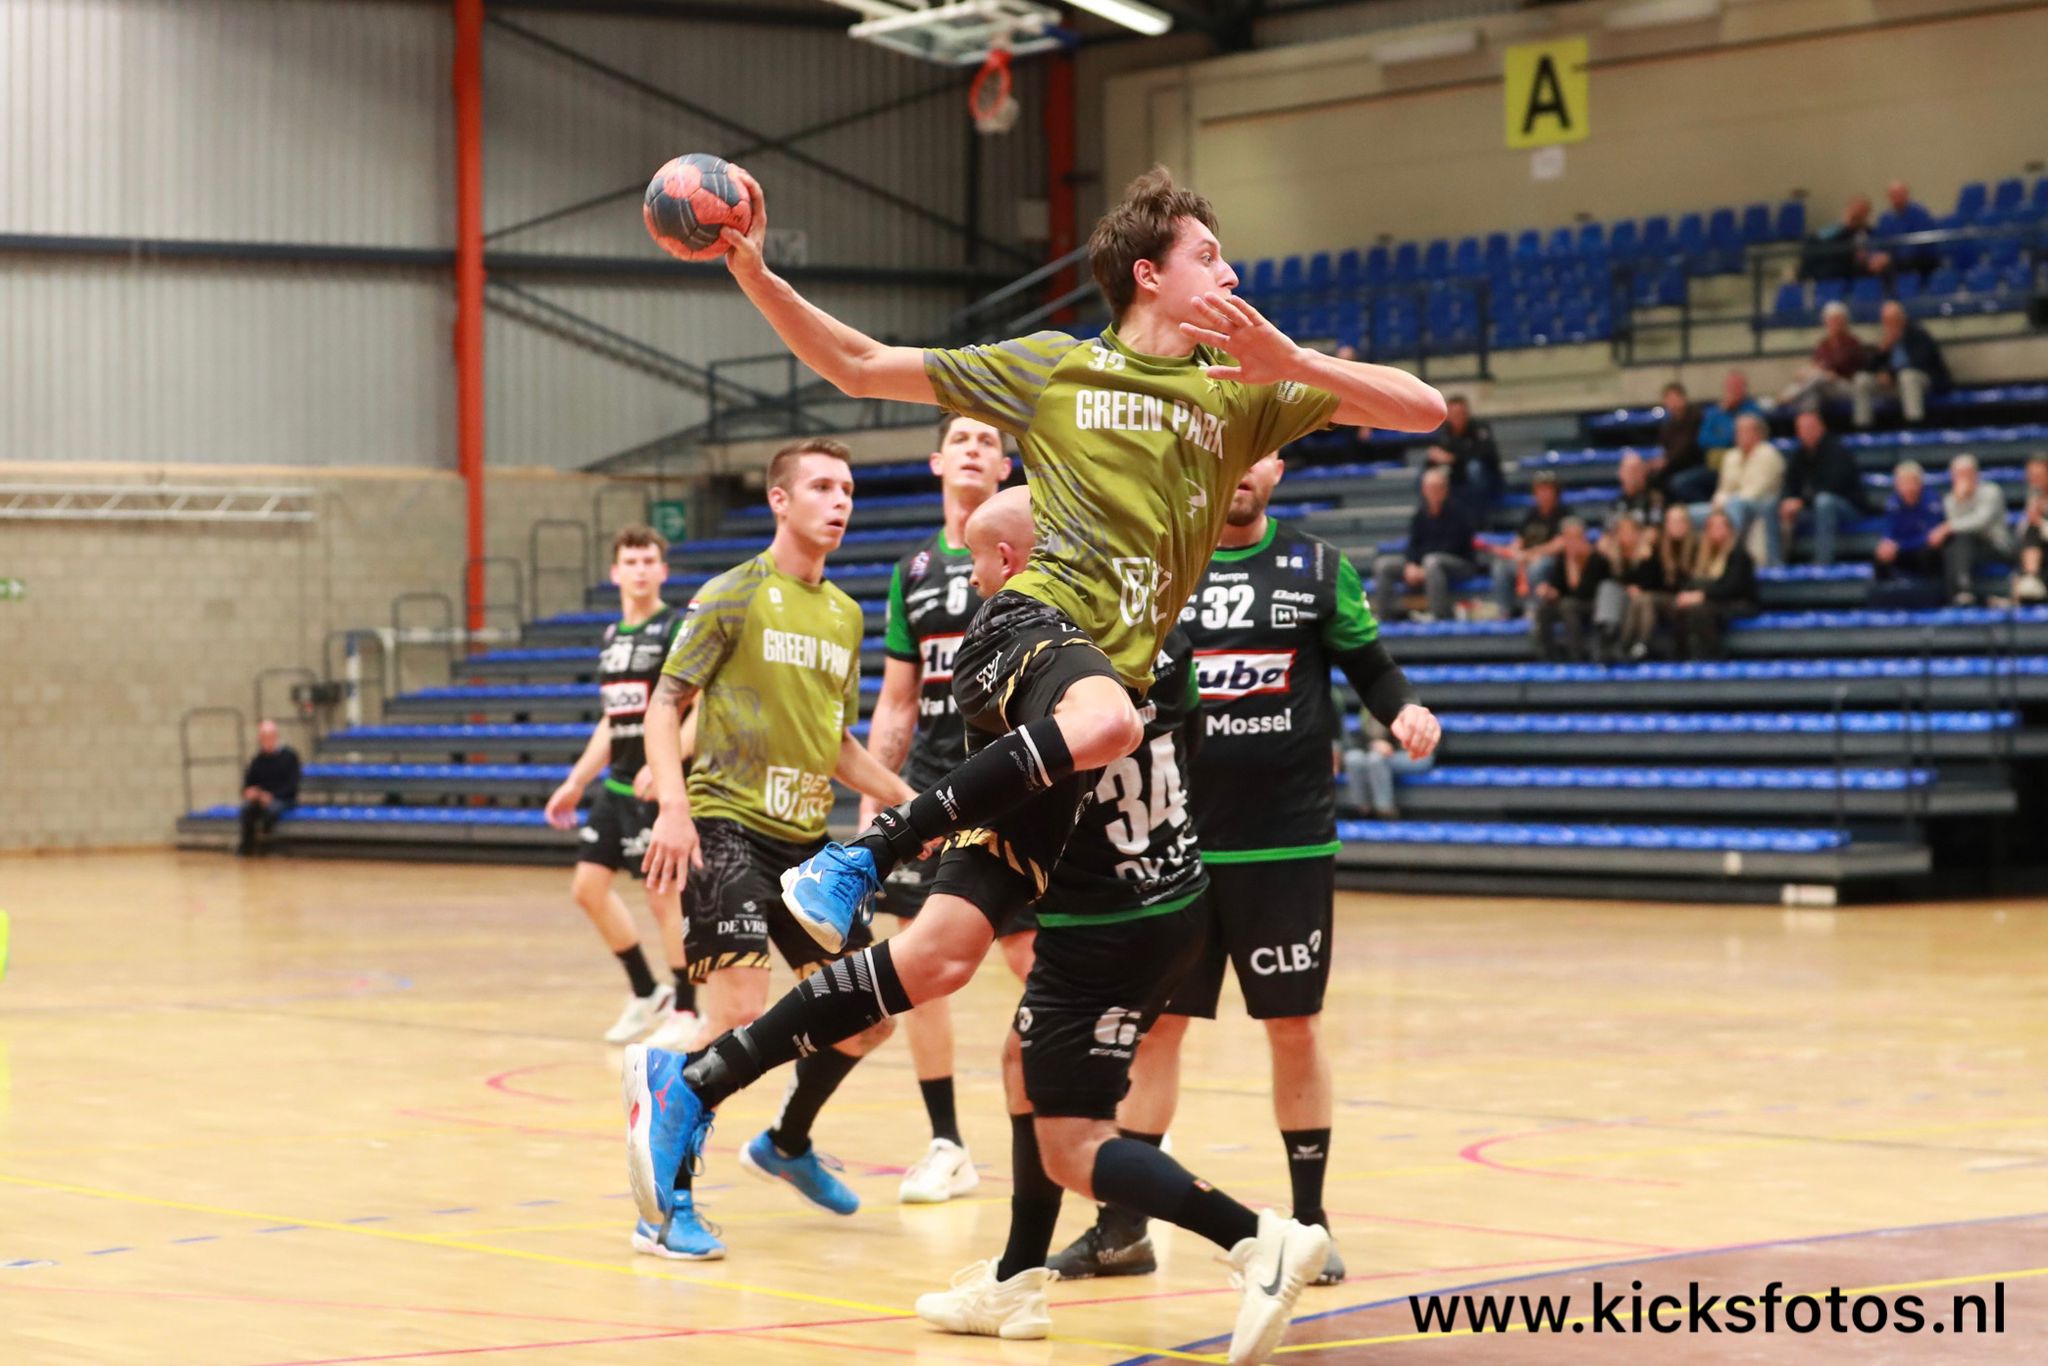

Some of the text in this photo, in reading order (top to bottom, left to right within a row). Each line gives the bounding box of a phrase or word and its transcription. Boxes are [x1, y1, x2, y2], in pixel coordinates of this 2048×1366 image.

[1522, 54, 1572, 134] A
[1076, 389, 1228, 460] GREEN PARK
[945, 576, 968, 616] 6
[1201, 584, 1255, 630] 32
[763, 628, 817, 670] GREEN
[1196, 660, 1287, 690] ubo
[1205, 708, 1292, 737] Mossel
[935, 789, 958, 821] erima
[1096, 731, 1188, 855] 34
[717, 920, 740, 935] DE
